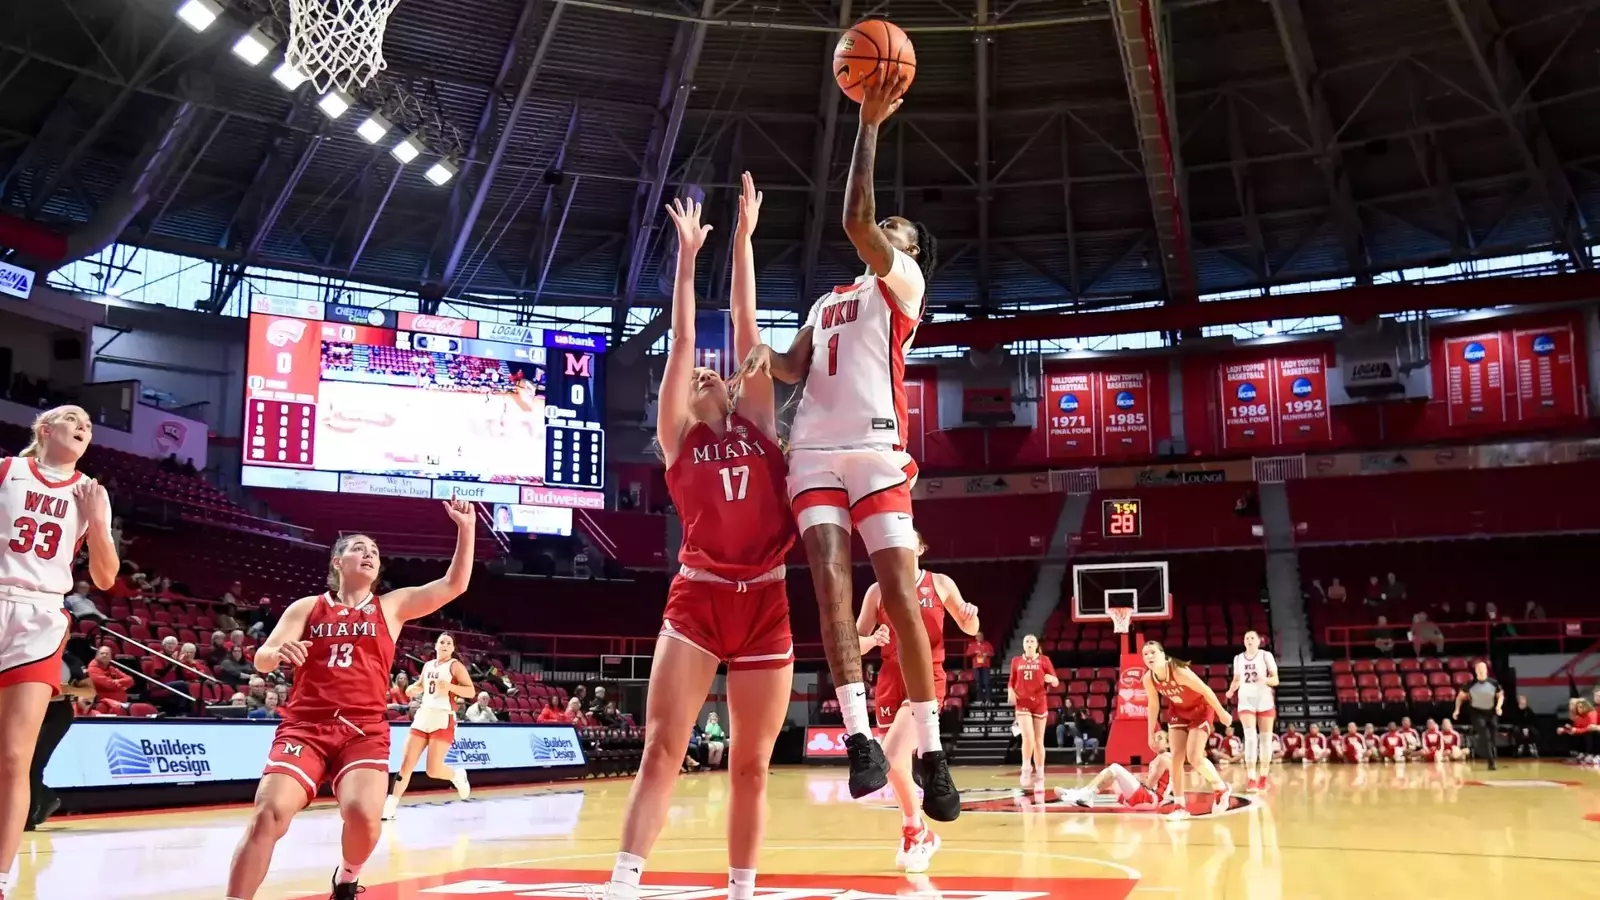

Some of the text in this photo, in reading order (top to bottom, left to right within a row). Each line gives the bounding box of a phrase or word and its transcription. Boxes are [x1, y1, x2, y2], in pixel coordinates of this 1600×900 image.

[335, 306, 368, 318] CHEETAH
[822, 299, 859, 330] WKU
[492, 325, 522, 336] LOGAN
[828, 333, 839, 376] 1
[276, 352, 292, 374] 0
[564, 353, 591, 377] M
[1226, 363, 1265, 374] LADY TOPPER
[1281, 358, 1320, 369] LADY TOPPER
[1106, 373, 1143, 382] LADY TOPPER
[1227, 371, 1264, 381] BASKETBALL
[1282, 367, 1320, 377] BASKETBALL
[1051, 375, 1088, 384] HILLTOPPER
[1107, 381, 1143, 390] BASKETBALL
[1051, 384, 1089, 392] BASKETBALL
[1237, 390, 1256, 398] NCAA
[1292, 385, 1312, 394] NCAA
[571, 384, 584, 405] 0
[1230, 404, 1267, 417] 1986
[1285, 399, 1323, 413] 1992
[1052, 416, 1086, 427] 1971
[1109, 413, 1144, 425] 1985
[719, 465, 750, 501] 17
[453, 485, 485, 497] Ruoff
[523, 489, 604, 507] Budweiser
[25, 490, 69, 519] WKU
[1113, 503, 1137, 514] 7:54
[1110, 514, 1134, 534] 28
[9, 516, 63, 560] 33
[310, 621, 377, 638] MIAMI
[327, 642, 354, 668] 13
[1024, 670, 1033, 680] 21
[428, 680, 436, 695] 0
[880, 706, 891, 717] M
[140, 739, 206, 756] Builders
[451, 738, 487, 750] Builders
[543, 737, 573, 748] Builders
[282, 743, 303, 758] M
[552, 748, 577, 761] Design
[460, 750, 491, 765] Design
[156, 756, 211, 776] Design
